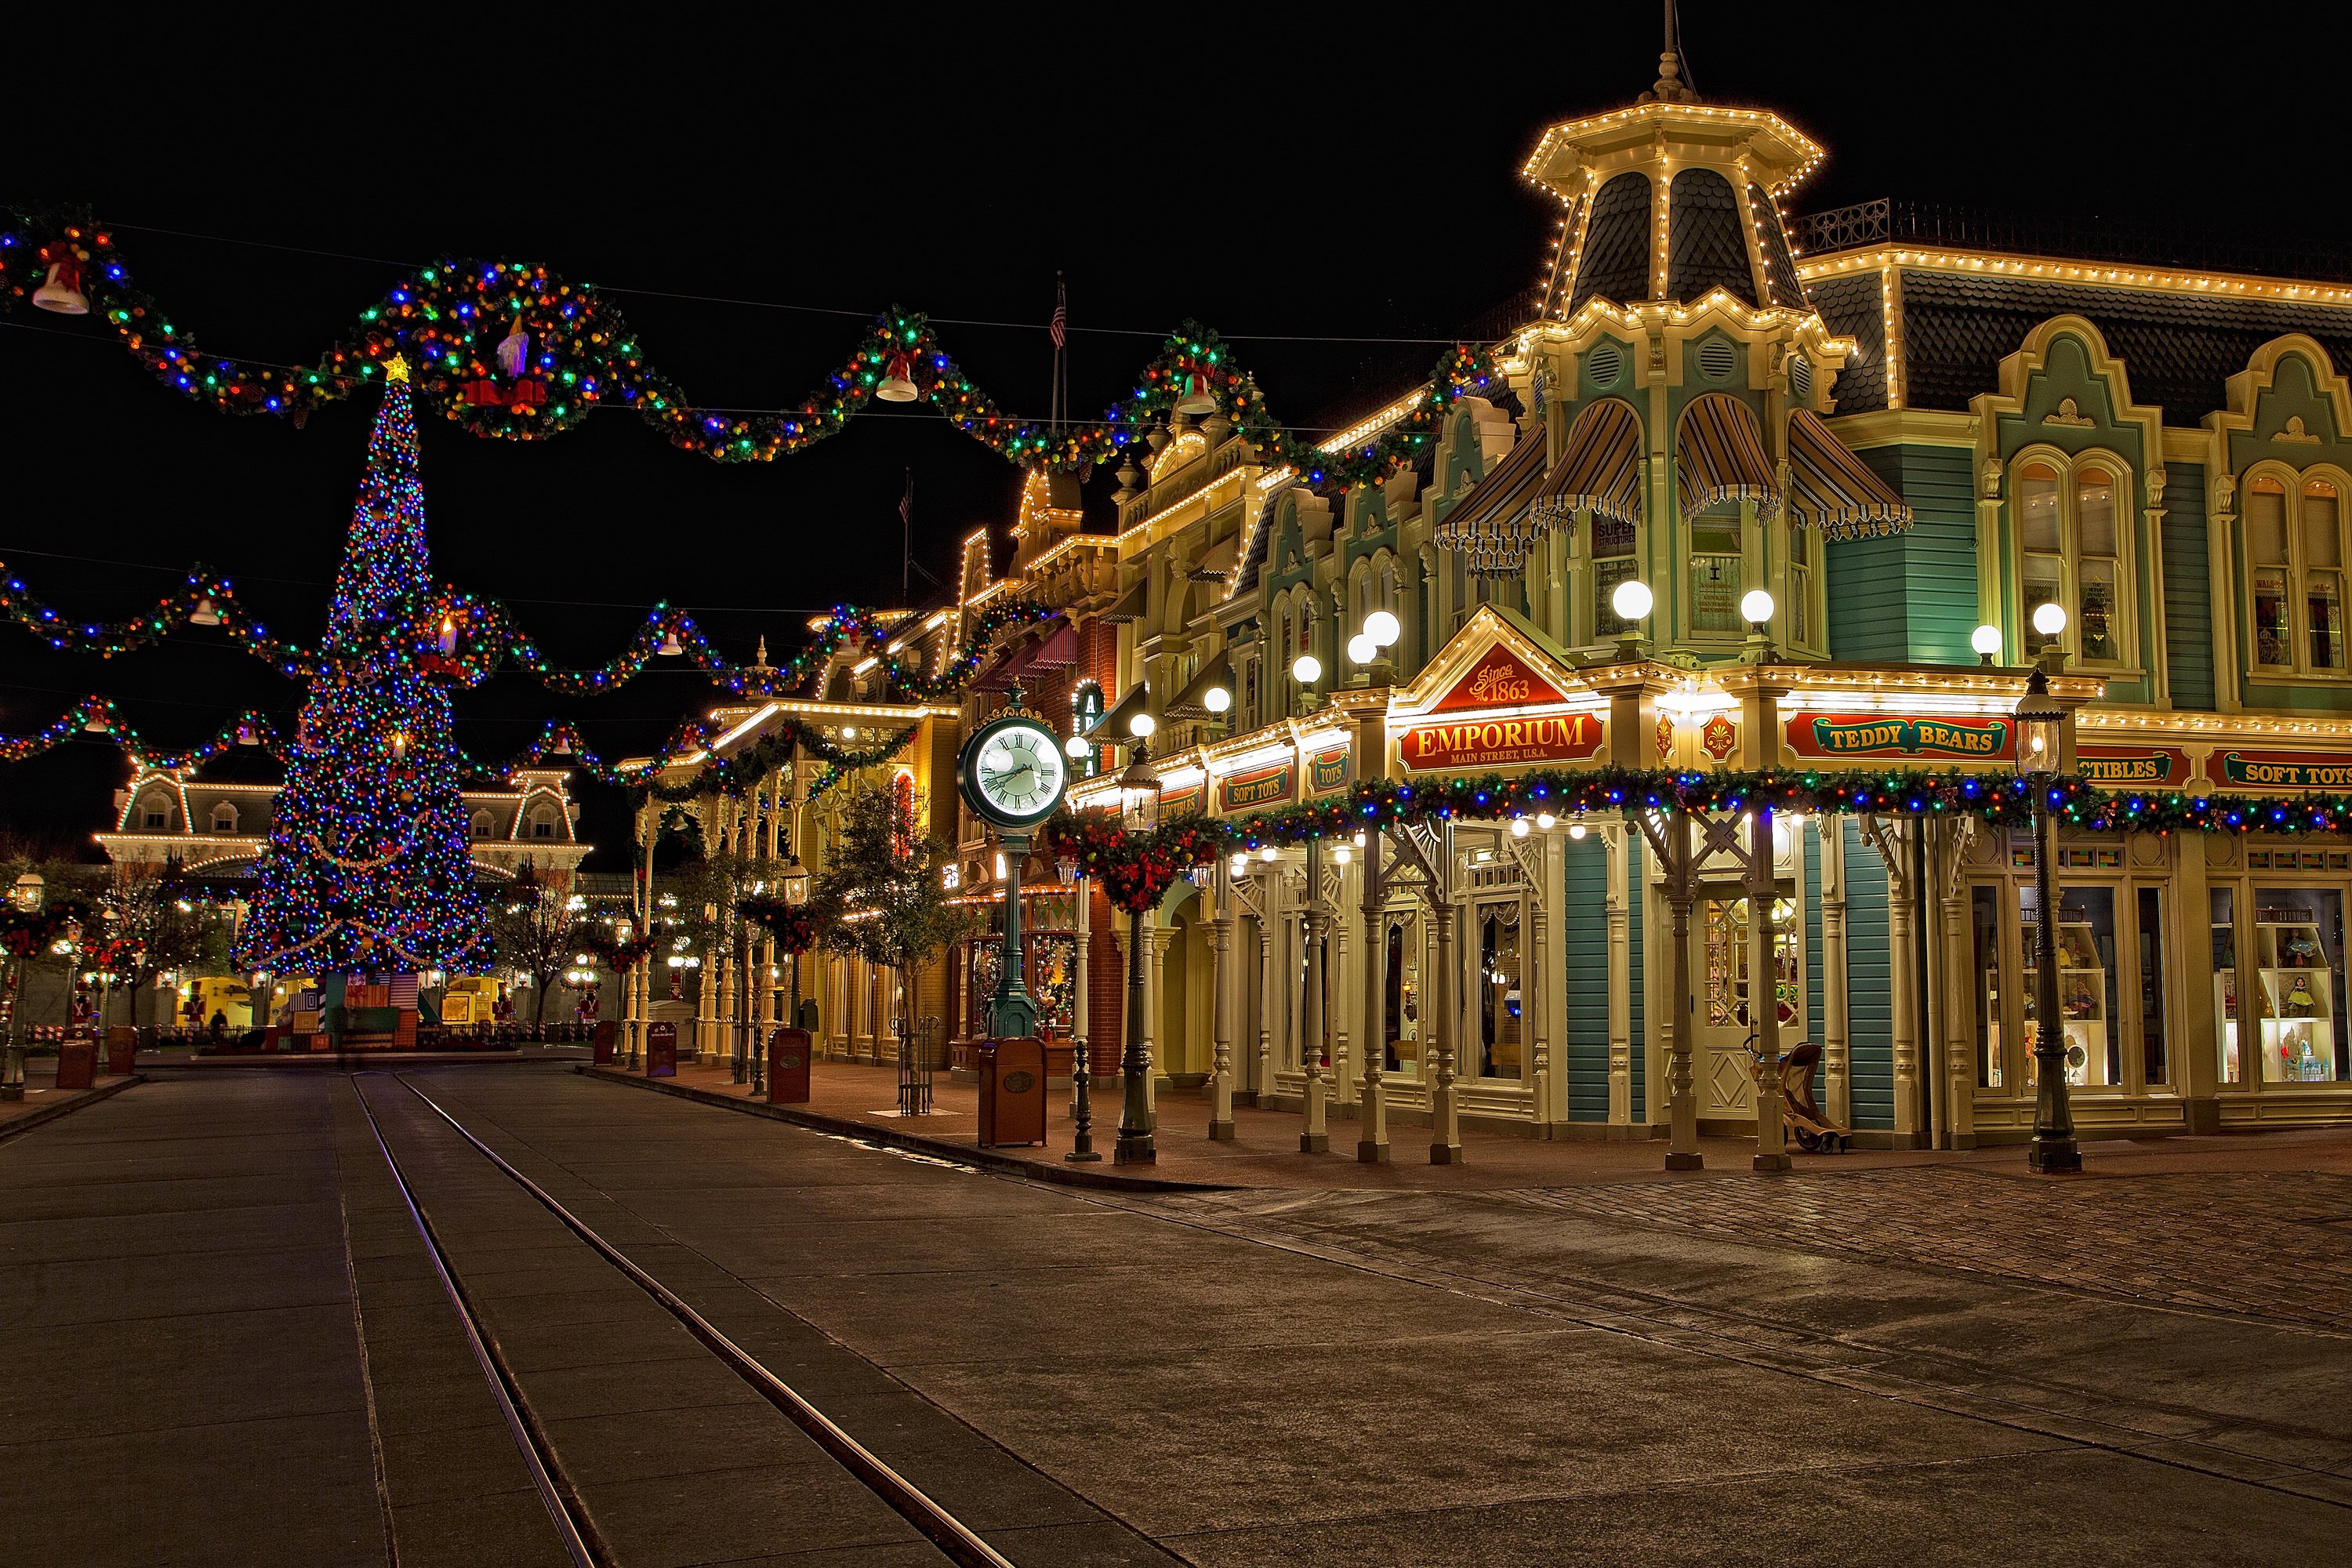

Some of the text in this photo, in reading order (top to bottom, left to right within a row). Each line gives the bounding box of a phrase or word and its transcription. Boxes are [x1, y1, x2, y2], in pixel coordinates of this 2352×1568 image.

[1598, 522, 1635, 538] SUPER
[1598, 535, 1635, 547] STRUCTURES
[1474, 664, 1513, 691] Since
[1490, 679, 1530, 702] 1863
[1416, 717, 1585, 757] EMPORIUM
[1830, 725, 1992, 751] TEDDY BEARS
[1450, 748, 1548, 764] MAIN STREET, U.S.A.
[1319, 764, 1342, 783] TOYS
[2078, 760, 2157, 778] CTIBLES
[2245, 764, 2300, 783] SOFT
[1233, 779, 1279, 802] SOFT TOYS
